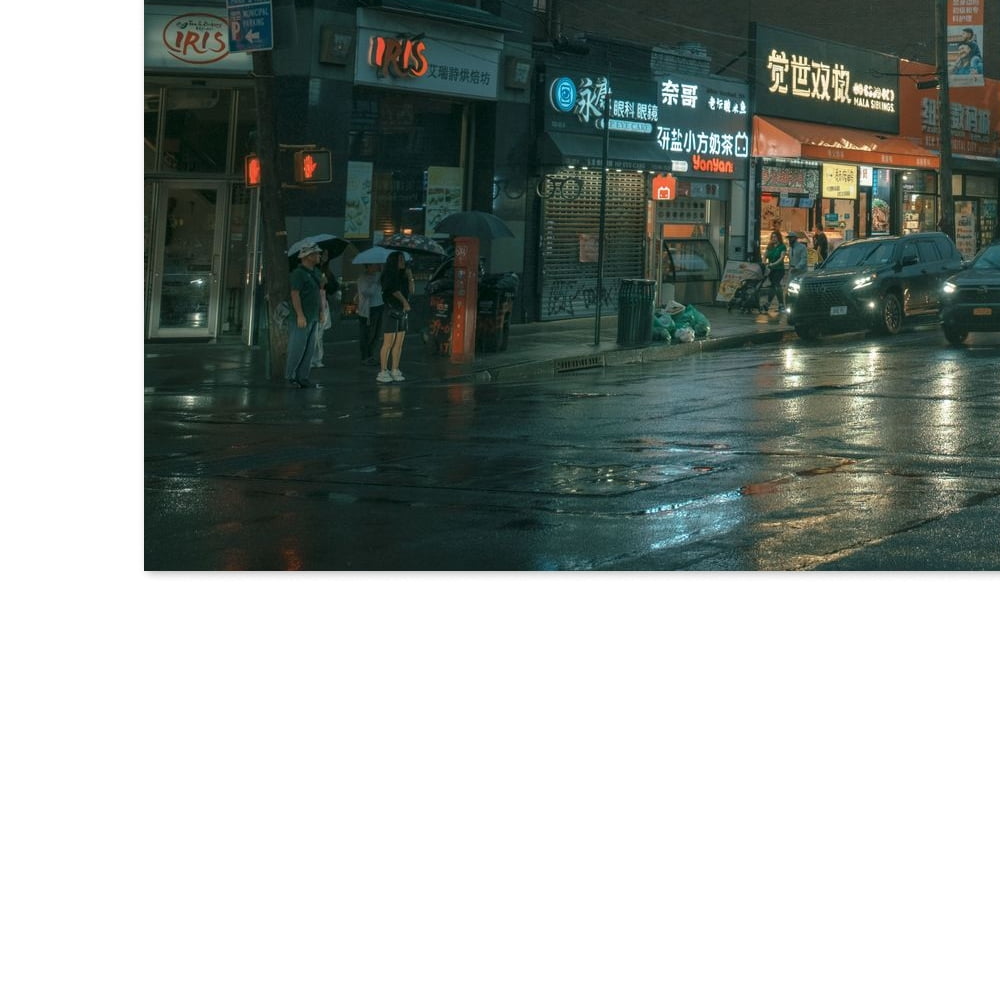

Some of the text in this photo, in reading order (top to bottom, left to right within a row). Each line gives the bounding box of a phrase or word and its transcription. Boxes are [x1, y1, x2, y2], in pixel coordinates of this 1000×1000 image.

[176, 31, 226, 55] IRIS
[368, 36, 429, 78] IRIS
[661, 79, 698, 108] 奈哥
